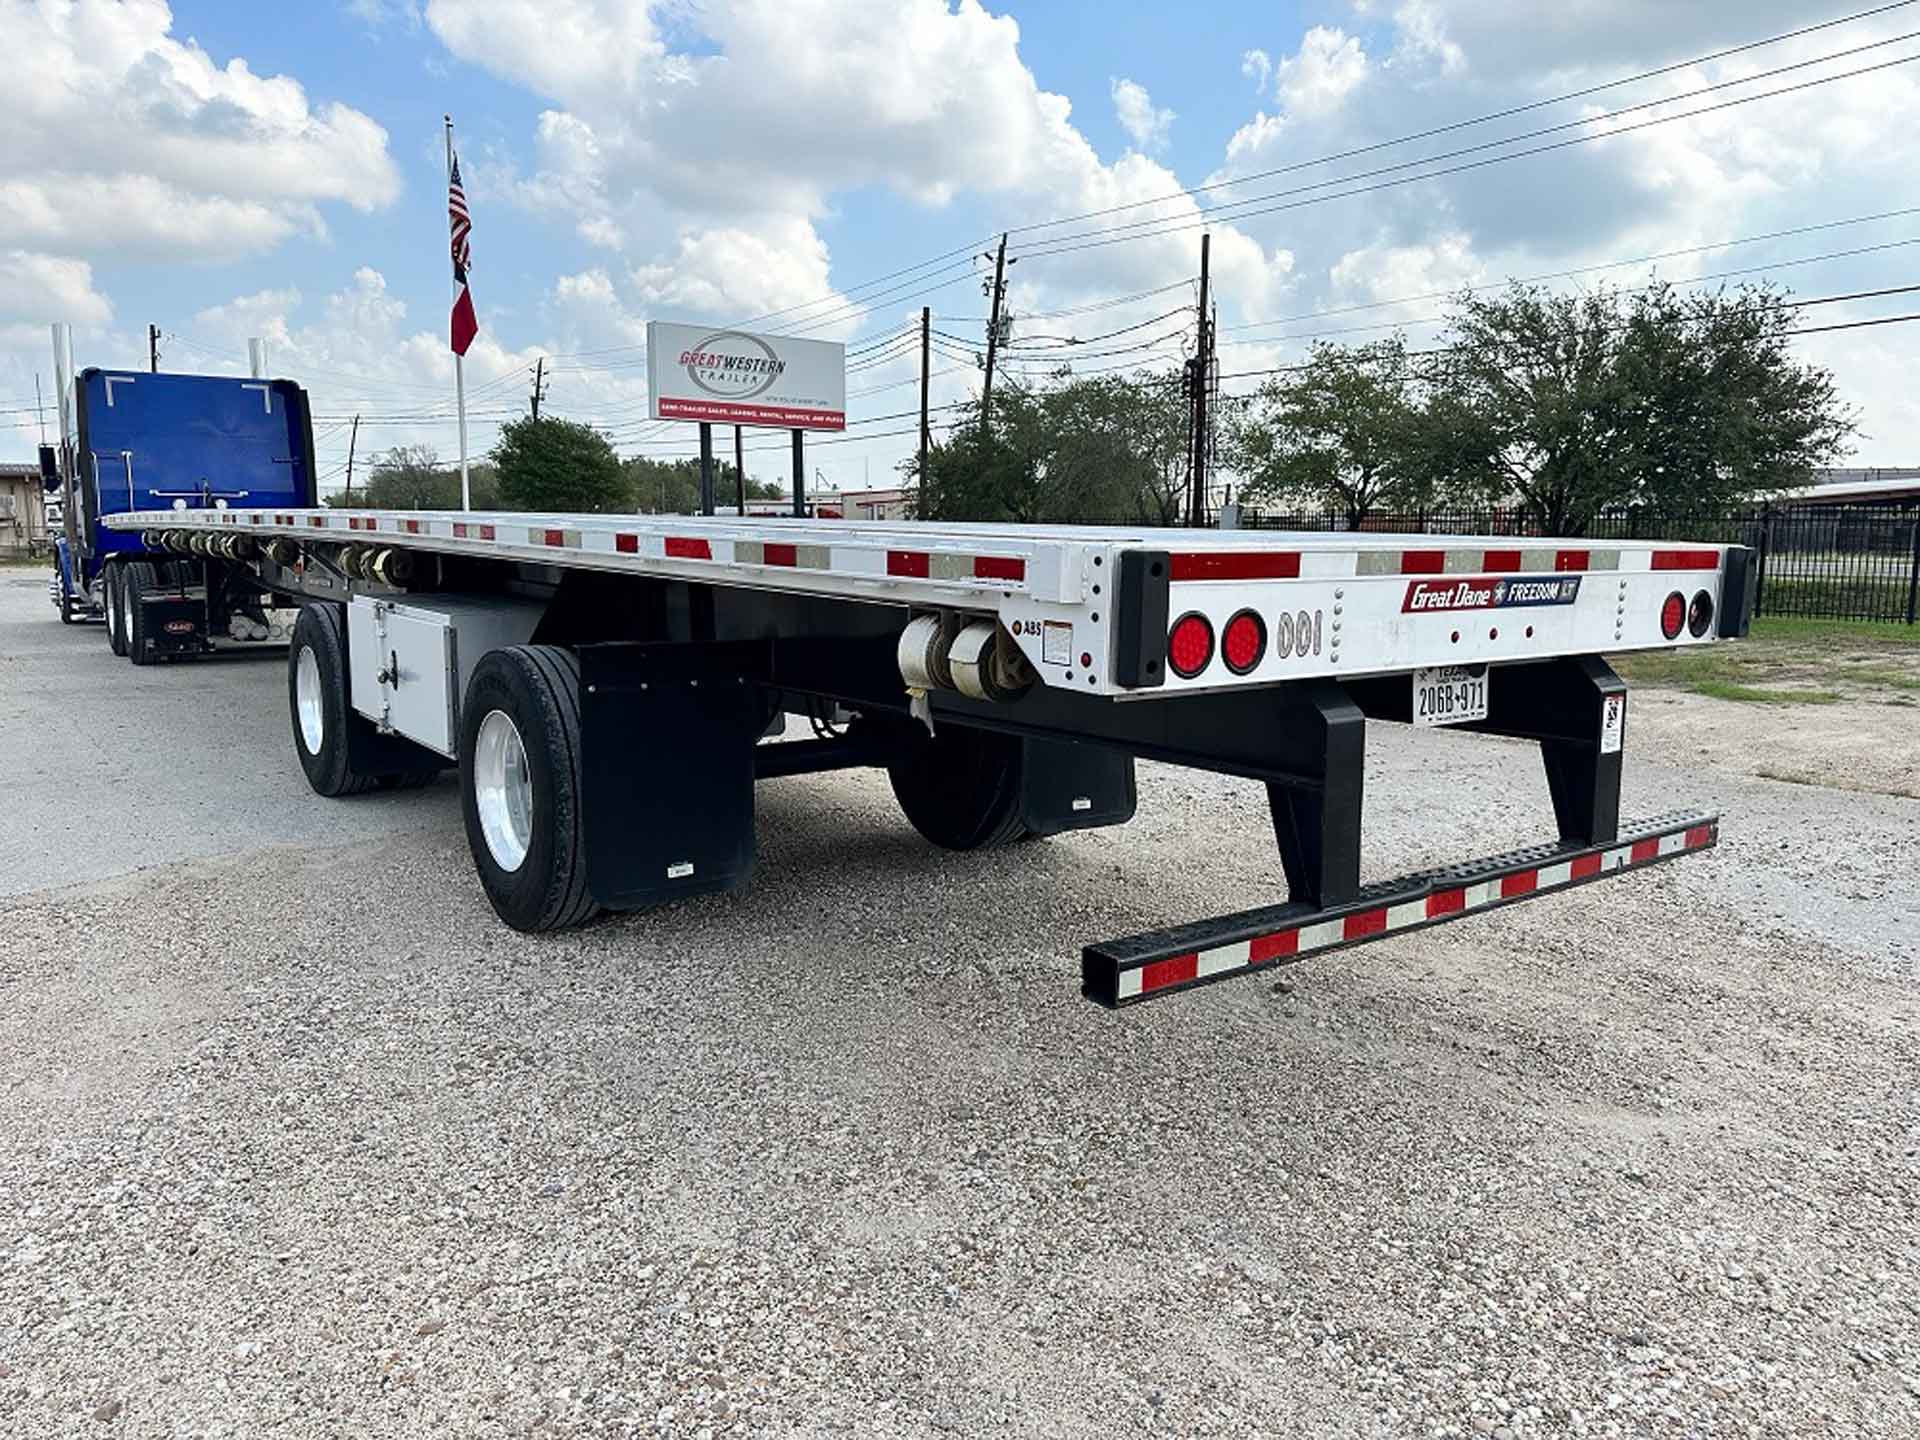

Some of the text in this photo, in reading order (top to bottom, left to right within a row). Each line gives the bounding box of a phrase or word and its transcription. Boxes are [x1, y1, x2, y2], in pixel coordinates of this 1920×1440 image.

[700, 369, 758, 384] TRAILER
[1410, 583, 1455, 609] Great
[1453, 582, 1491, 607] Dane
[1507, 582, 1560, 602] FREEDOM
[1024, 620, 1041, 636] ABS
[1277, 609, 1322, 659] 001
